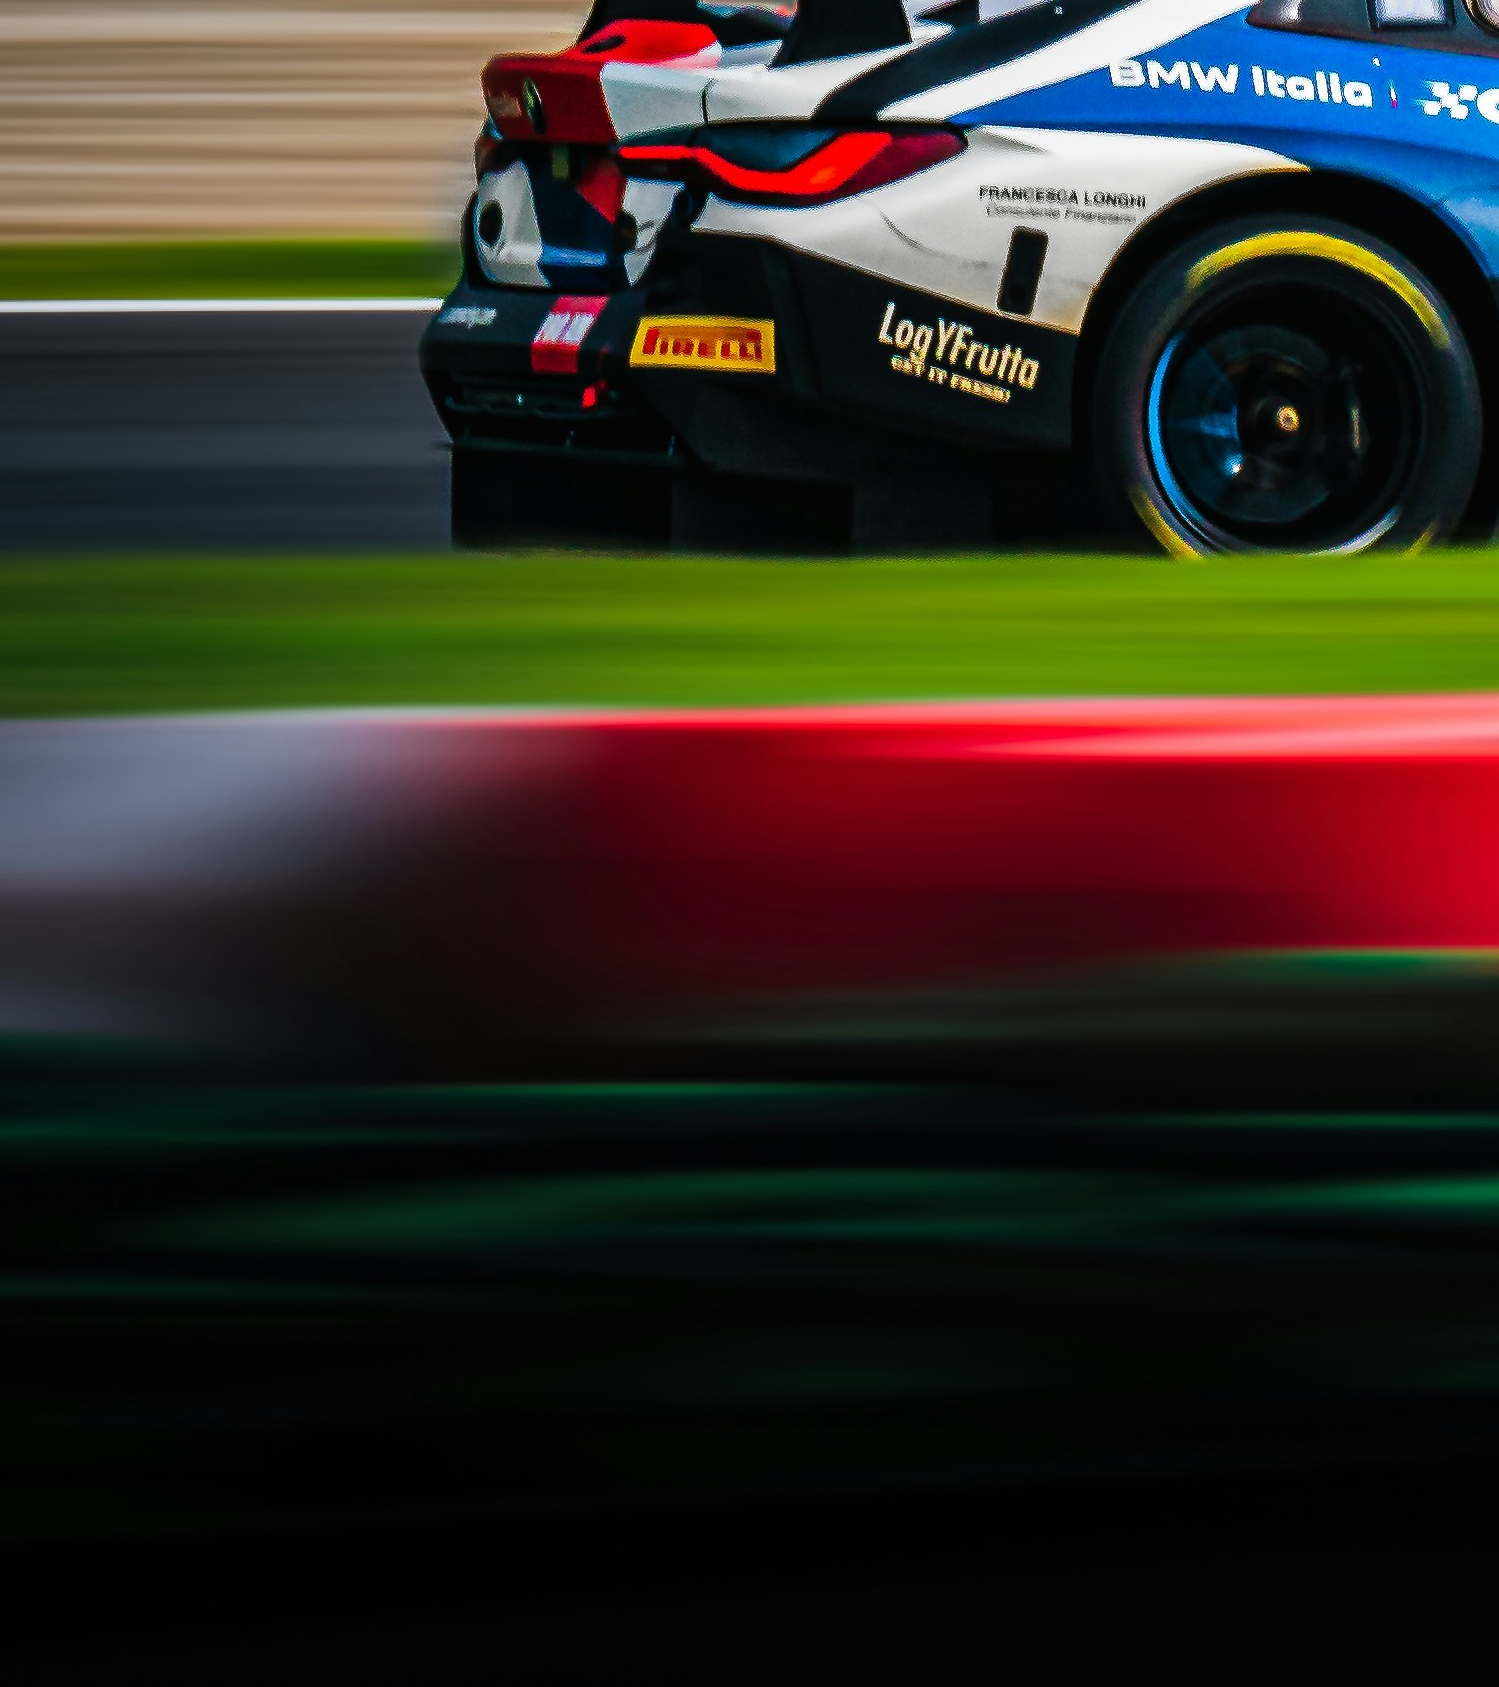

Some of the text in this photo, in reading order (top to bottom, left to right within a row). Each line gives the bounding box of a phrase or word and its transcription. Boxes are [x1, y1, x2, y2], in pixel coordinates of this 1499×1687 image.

[1109, 60, 1373, 108] BMW Italia
[979, 185, 1147, 210] FRANCESCA LONGHI
